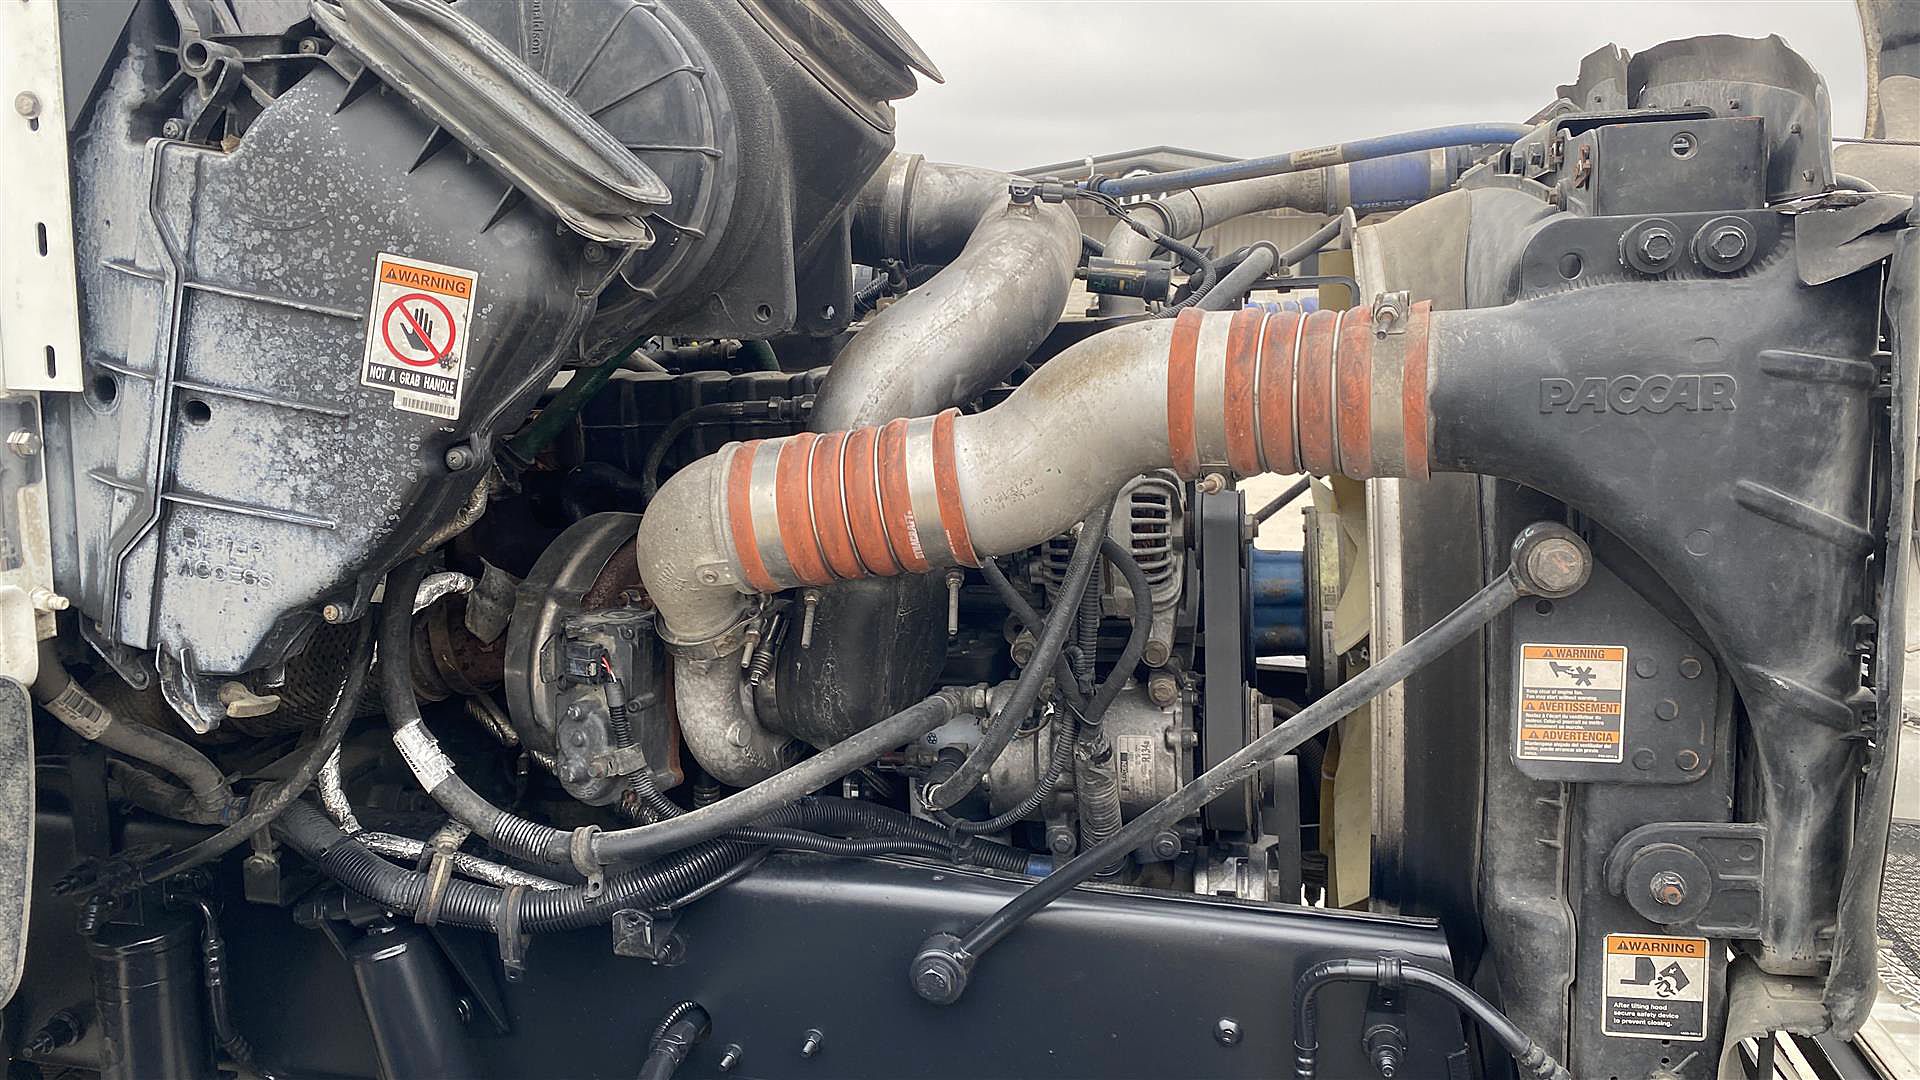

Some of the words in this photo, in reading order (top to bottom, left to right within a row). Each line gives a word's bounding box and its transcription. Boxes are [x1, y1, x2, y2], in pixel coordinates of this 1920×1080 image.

[399, 270, 466, 294] WARNING
[369, 365, 386, 381] NOT
[389, 371, 396, 383] A
[400, 372, 420, 388] GRAB
[423, 376, 455, 395] HANDLE
[1539, 374, 1738, 415] PACCAR
[179, 558, 273, 590] ACCESS
[1556, 648, 1605, 659] WARNING
[1538, 702, 1619, 713] AVERTISSEMENT
[1542, 731, 1613, 742] ADVERTENCIA
[1628, 941, 1695, 954] WARNING
[1613, 1001, 1629, 1009] After
[1630, 1002, 1649, 1011] tilting
[1650, 1003, 1668, 1011] hood
[1657, 1012, 1679, 1020] device
[1647, 1019, 1673, 1028] closing.
